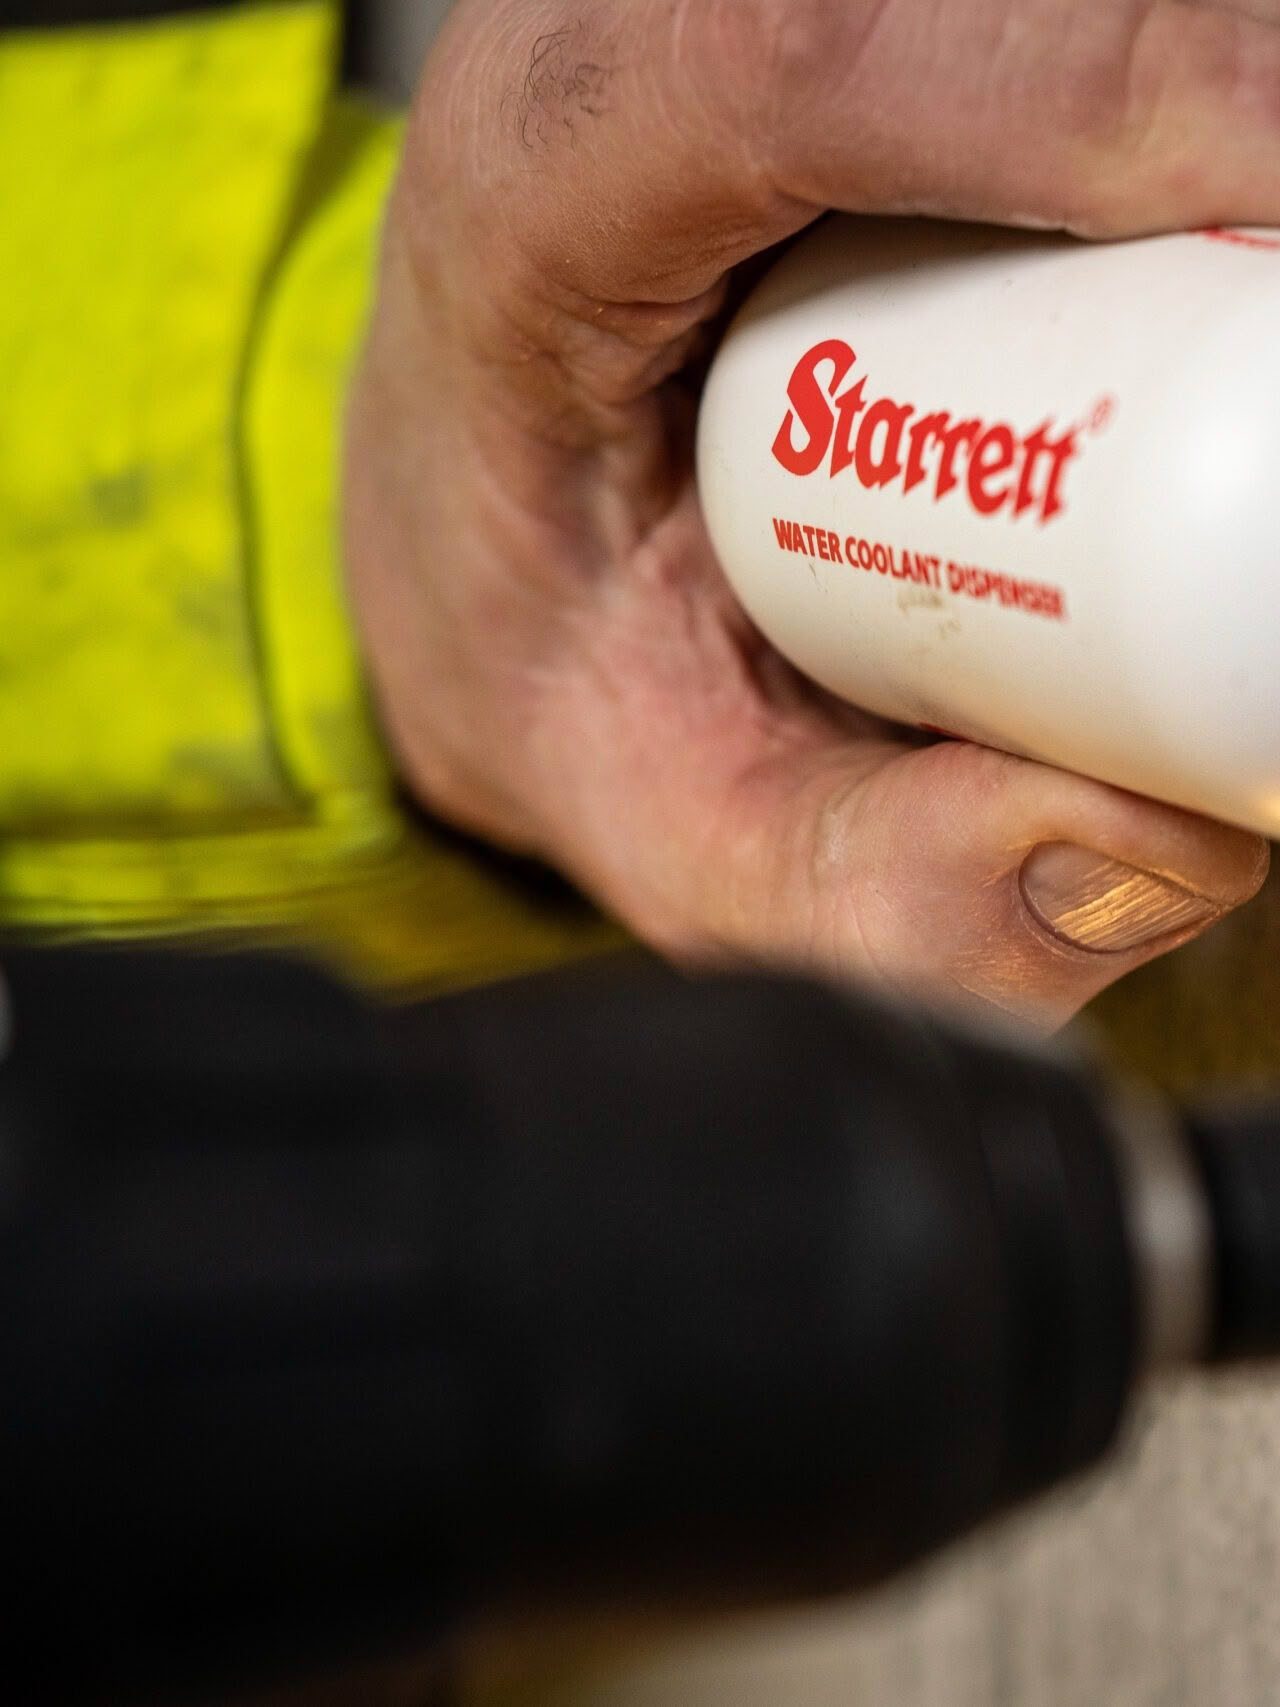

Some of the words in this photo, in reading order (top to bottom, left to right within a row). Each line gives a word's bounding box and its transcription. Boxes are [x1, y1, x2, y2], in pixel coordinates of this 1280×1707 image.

[771, 338, 1078, 525] Starrett
[772, 517, 843, 564] WATER
[844, 536, 941, 588] COOLANT
